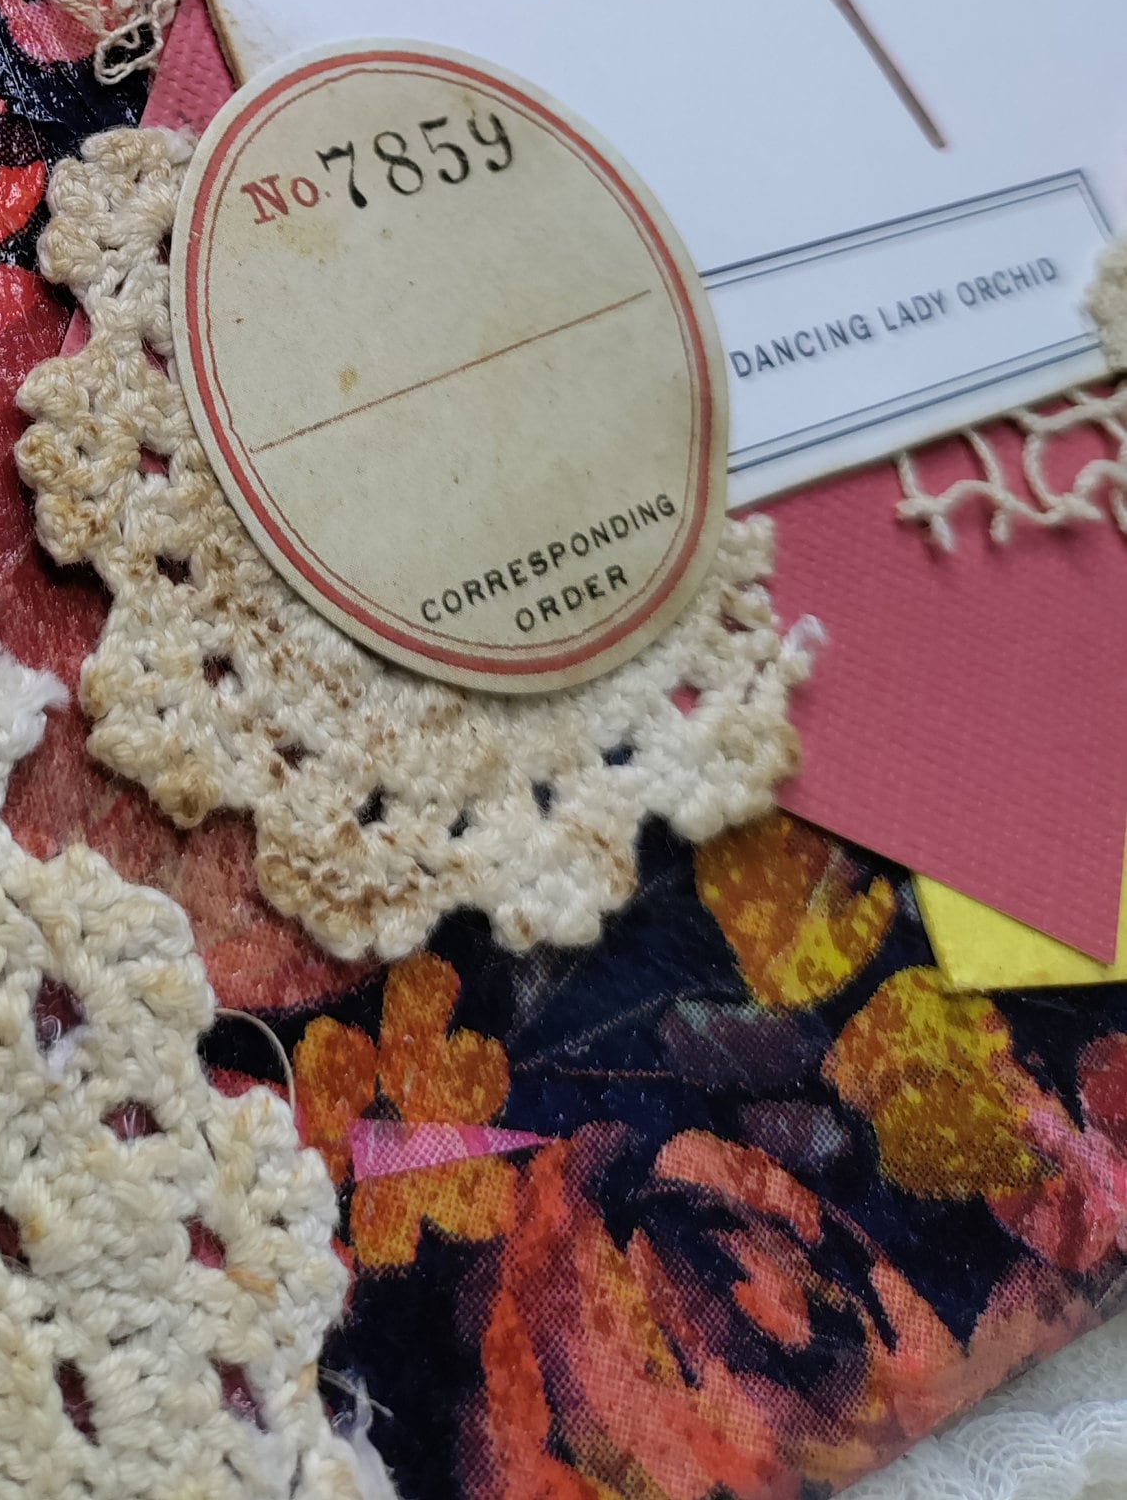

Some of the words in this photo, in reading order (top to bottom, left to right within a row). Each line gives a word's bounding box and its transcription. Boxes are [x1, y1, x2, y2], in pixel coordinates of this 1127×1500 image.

[315, 111, 514, 210] 7859
[728, 312, 873, 379] DANCING
[877, 290, 948, 333] LADY
[955, 256, 1061, 309] ORCHID
[420, 493, 676, 624] CORRESPONDING
[513, 563, 629, 633] ORDER
